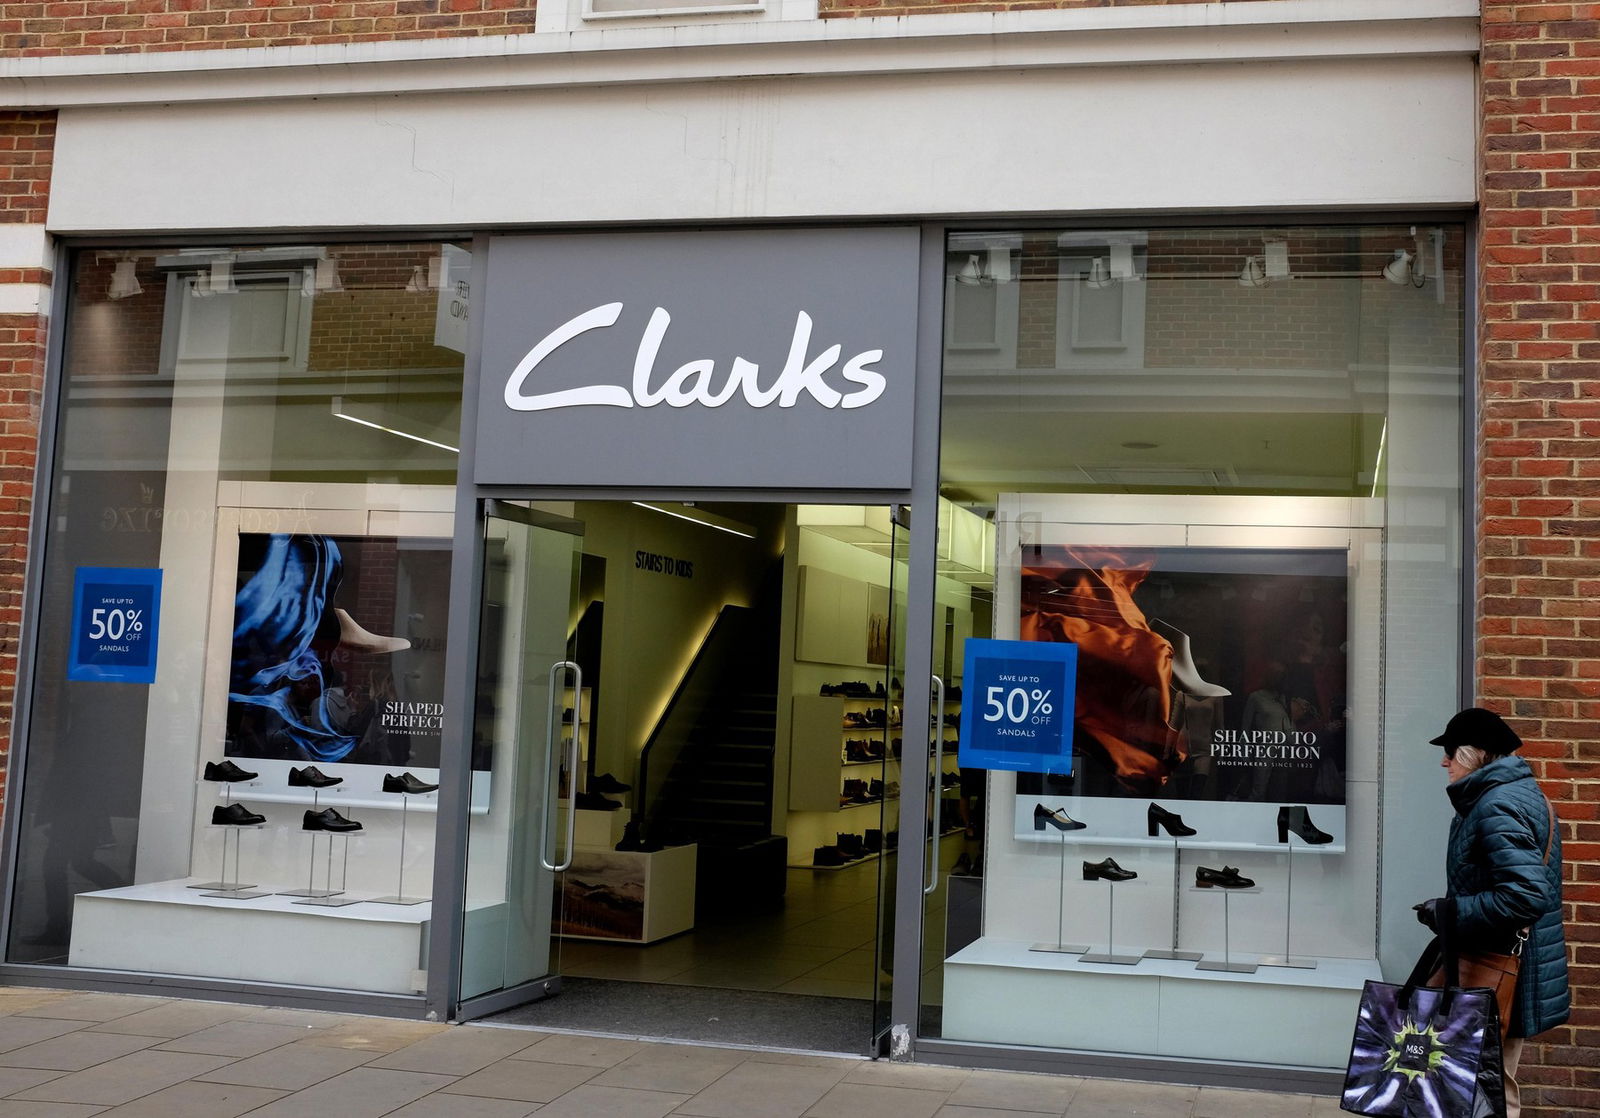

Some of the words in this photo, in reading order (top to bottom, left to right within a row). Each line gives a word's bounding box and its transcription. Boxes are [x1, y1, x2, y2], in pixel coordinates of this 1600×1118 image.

[504, 301, 887, 411] Clarks
[635, 550, 662, 573] STAIRS
[663, 556, 674, 575] TO
[675, 559, 693, 579] KIDS
[89, 608, 143, 640] 50%
[125, 633, 142, 641] OFF
[99, 644, 130, 652] SANDALS
[999, 674, 1016, 682] SAVE
[385, 701, 444, 715] SHAPED
[983, 686, 1053, 723] 50%
[1031, 716, 1052, 725] OFF
[997, 728, 1036, 738] SANDALS
[1214, 729, 1287, 744] SHAPED
[1291, 731, 1317, 745] TO
[1210, 743, 1320, 760] PERFECTION
[1406, 1044, 1424, 1055] M&S
